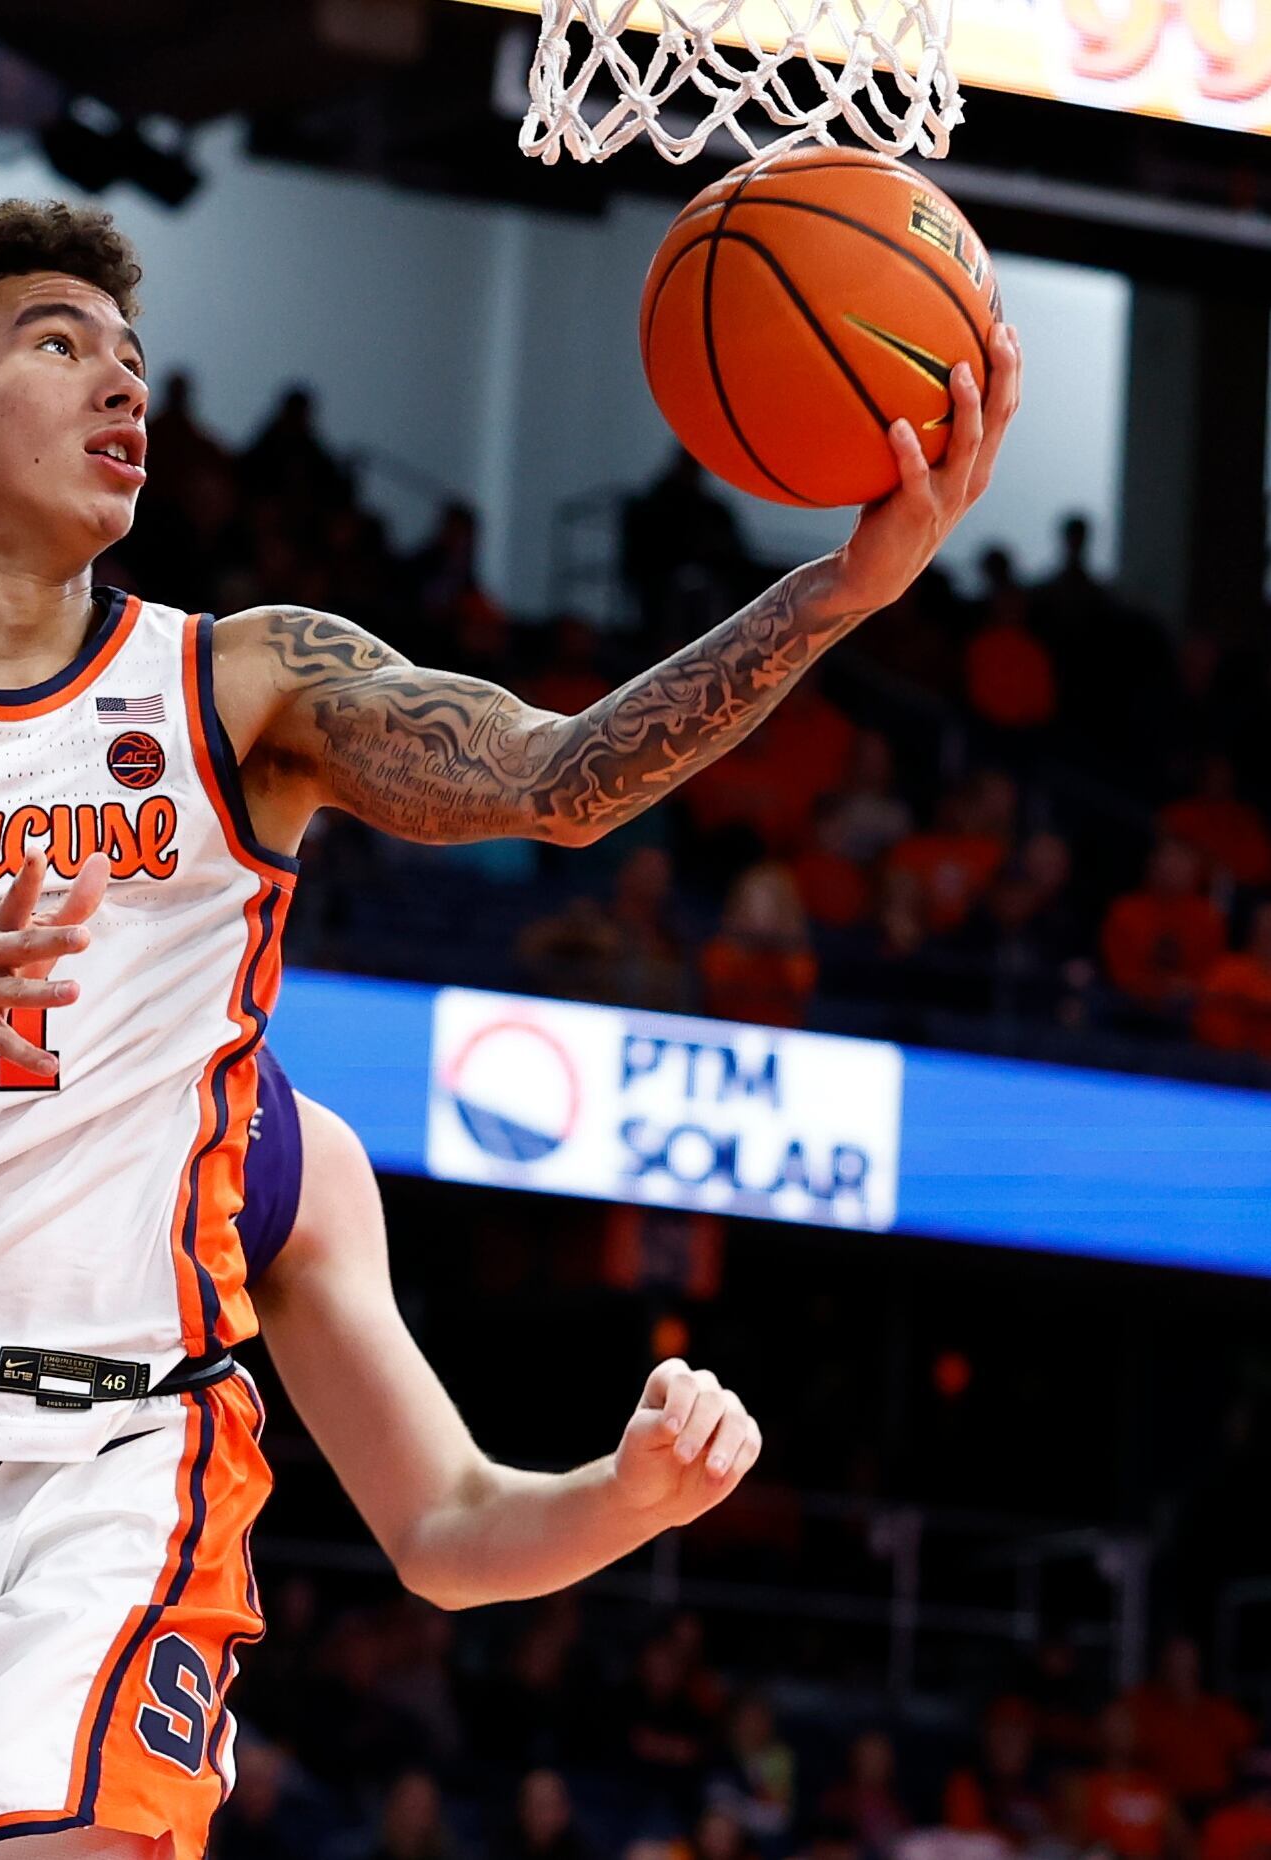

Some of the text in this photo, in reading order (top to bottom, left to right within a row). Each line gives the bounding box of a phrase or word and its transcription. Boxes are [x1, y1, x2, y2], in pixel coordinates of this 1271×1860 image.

[116, 750, 161, 764] ACC
[622, 1034, 781, 1110] PTM
[621, 1114, 873, 1204] SOLAR
[101, 1373, 128, 1392] 46
[135, 1631, 215, 1777] S
